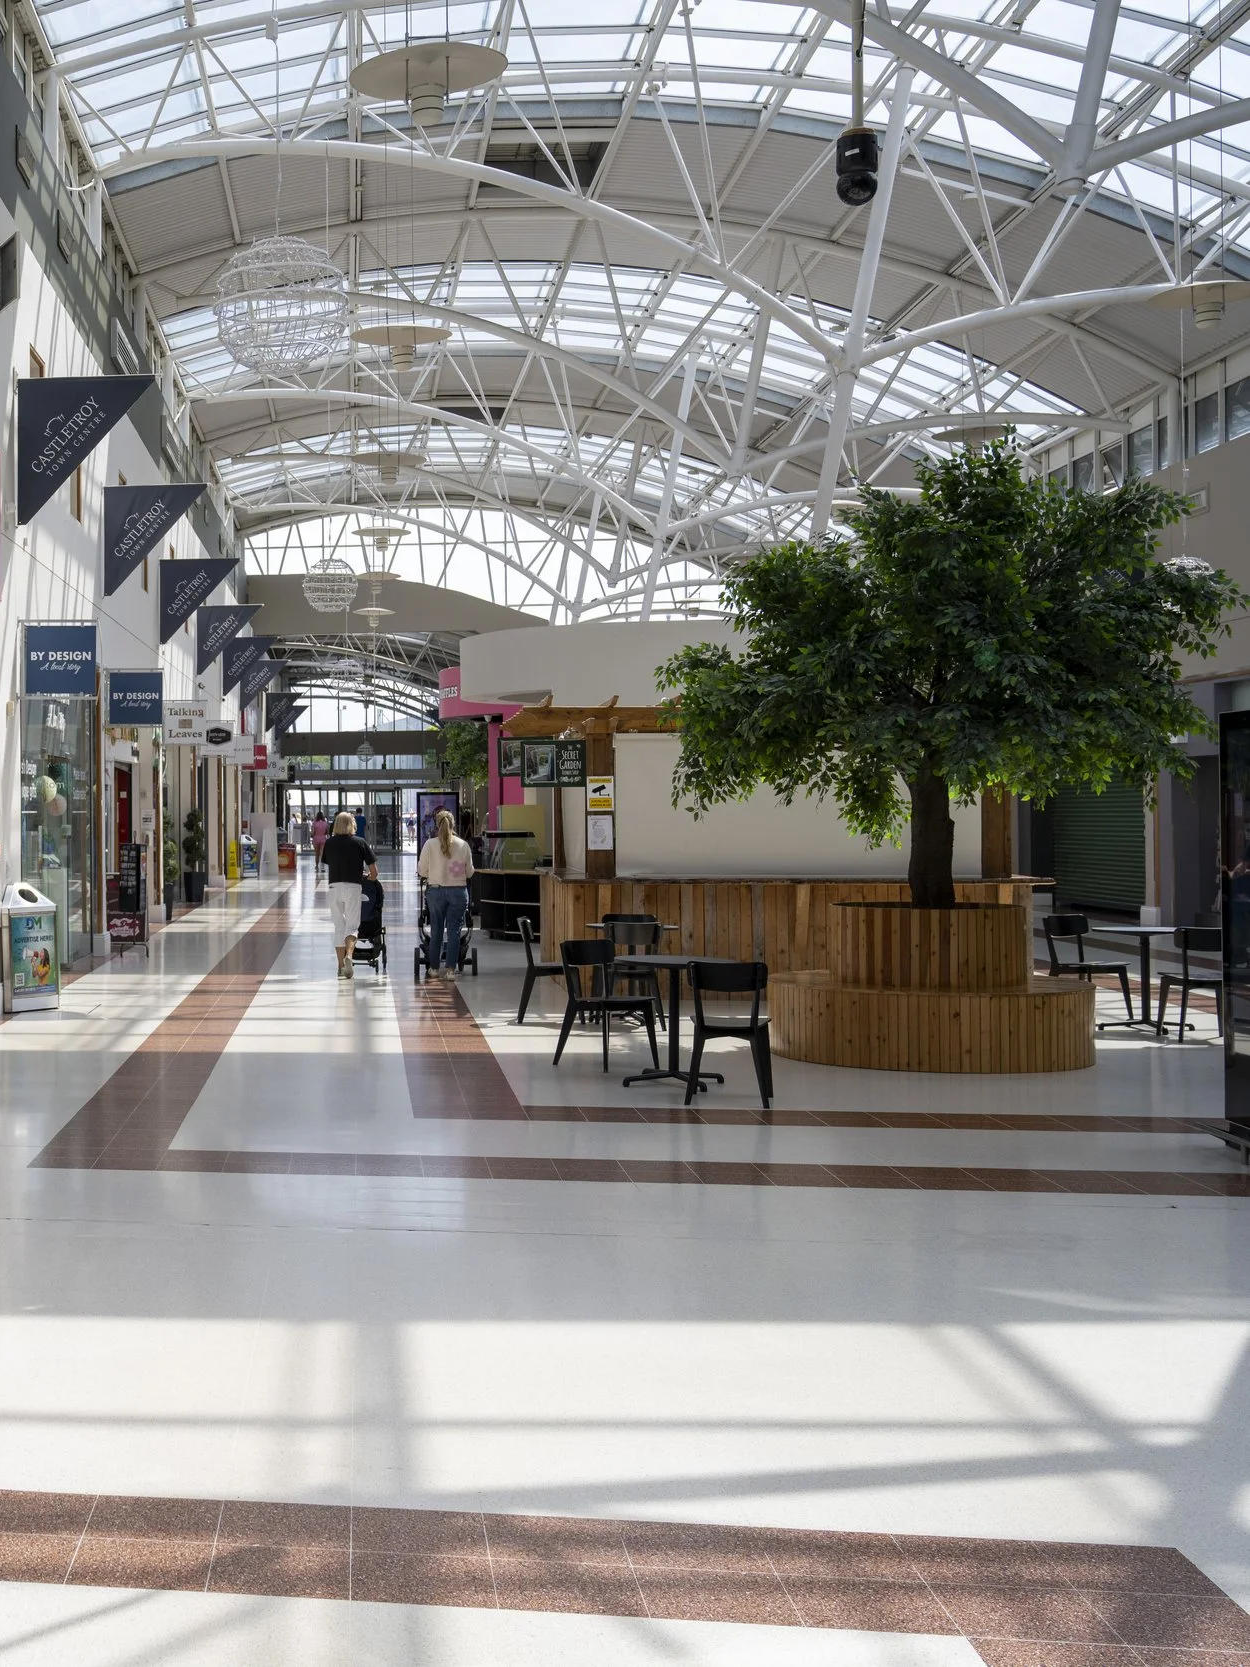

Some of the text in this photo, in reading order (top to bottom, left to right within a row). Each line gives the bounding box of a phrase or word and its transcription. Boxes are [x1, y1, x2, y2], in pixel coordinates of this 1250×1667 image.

[31, 396, 100, 473] CASTLETROY
[46, 410, 107, 477] TOWN CENTRE
[114, 499, 166, 558] CASTLETROY
[126, 510, 171, 560] TOWN CENTRE
[167, 569, 207, 615] CASTLETROY
[203, 613, 236, 651] CASTLETROY
[30, 651, 92, 661] BY DESIGN
[40, 662, 82, 674] A local story
[113, 692, 159, 700] BY DESIGN
[167, 707, 204, 717] Talking
[168, 730, 203, 738] Leaves
[561, 749, 579, 760] SECRET
[559, 760, 582, 770] GARDEN
